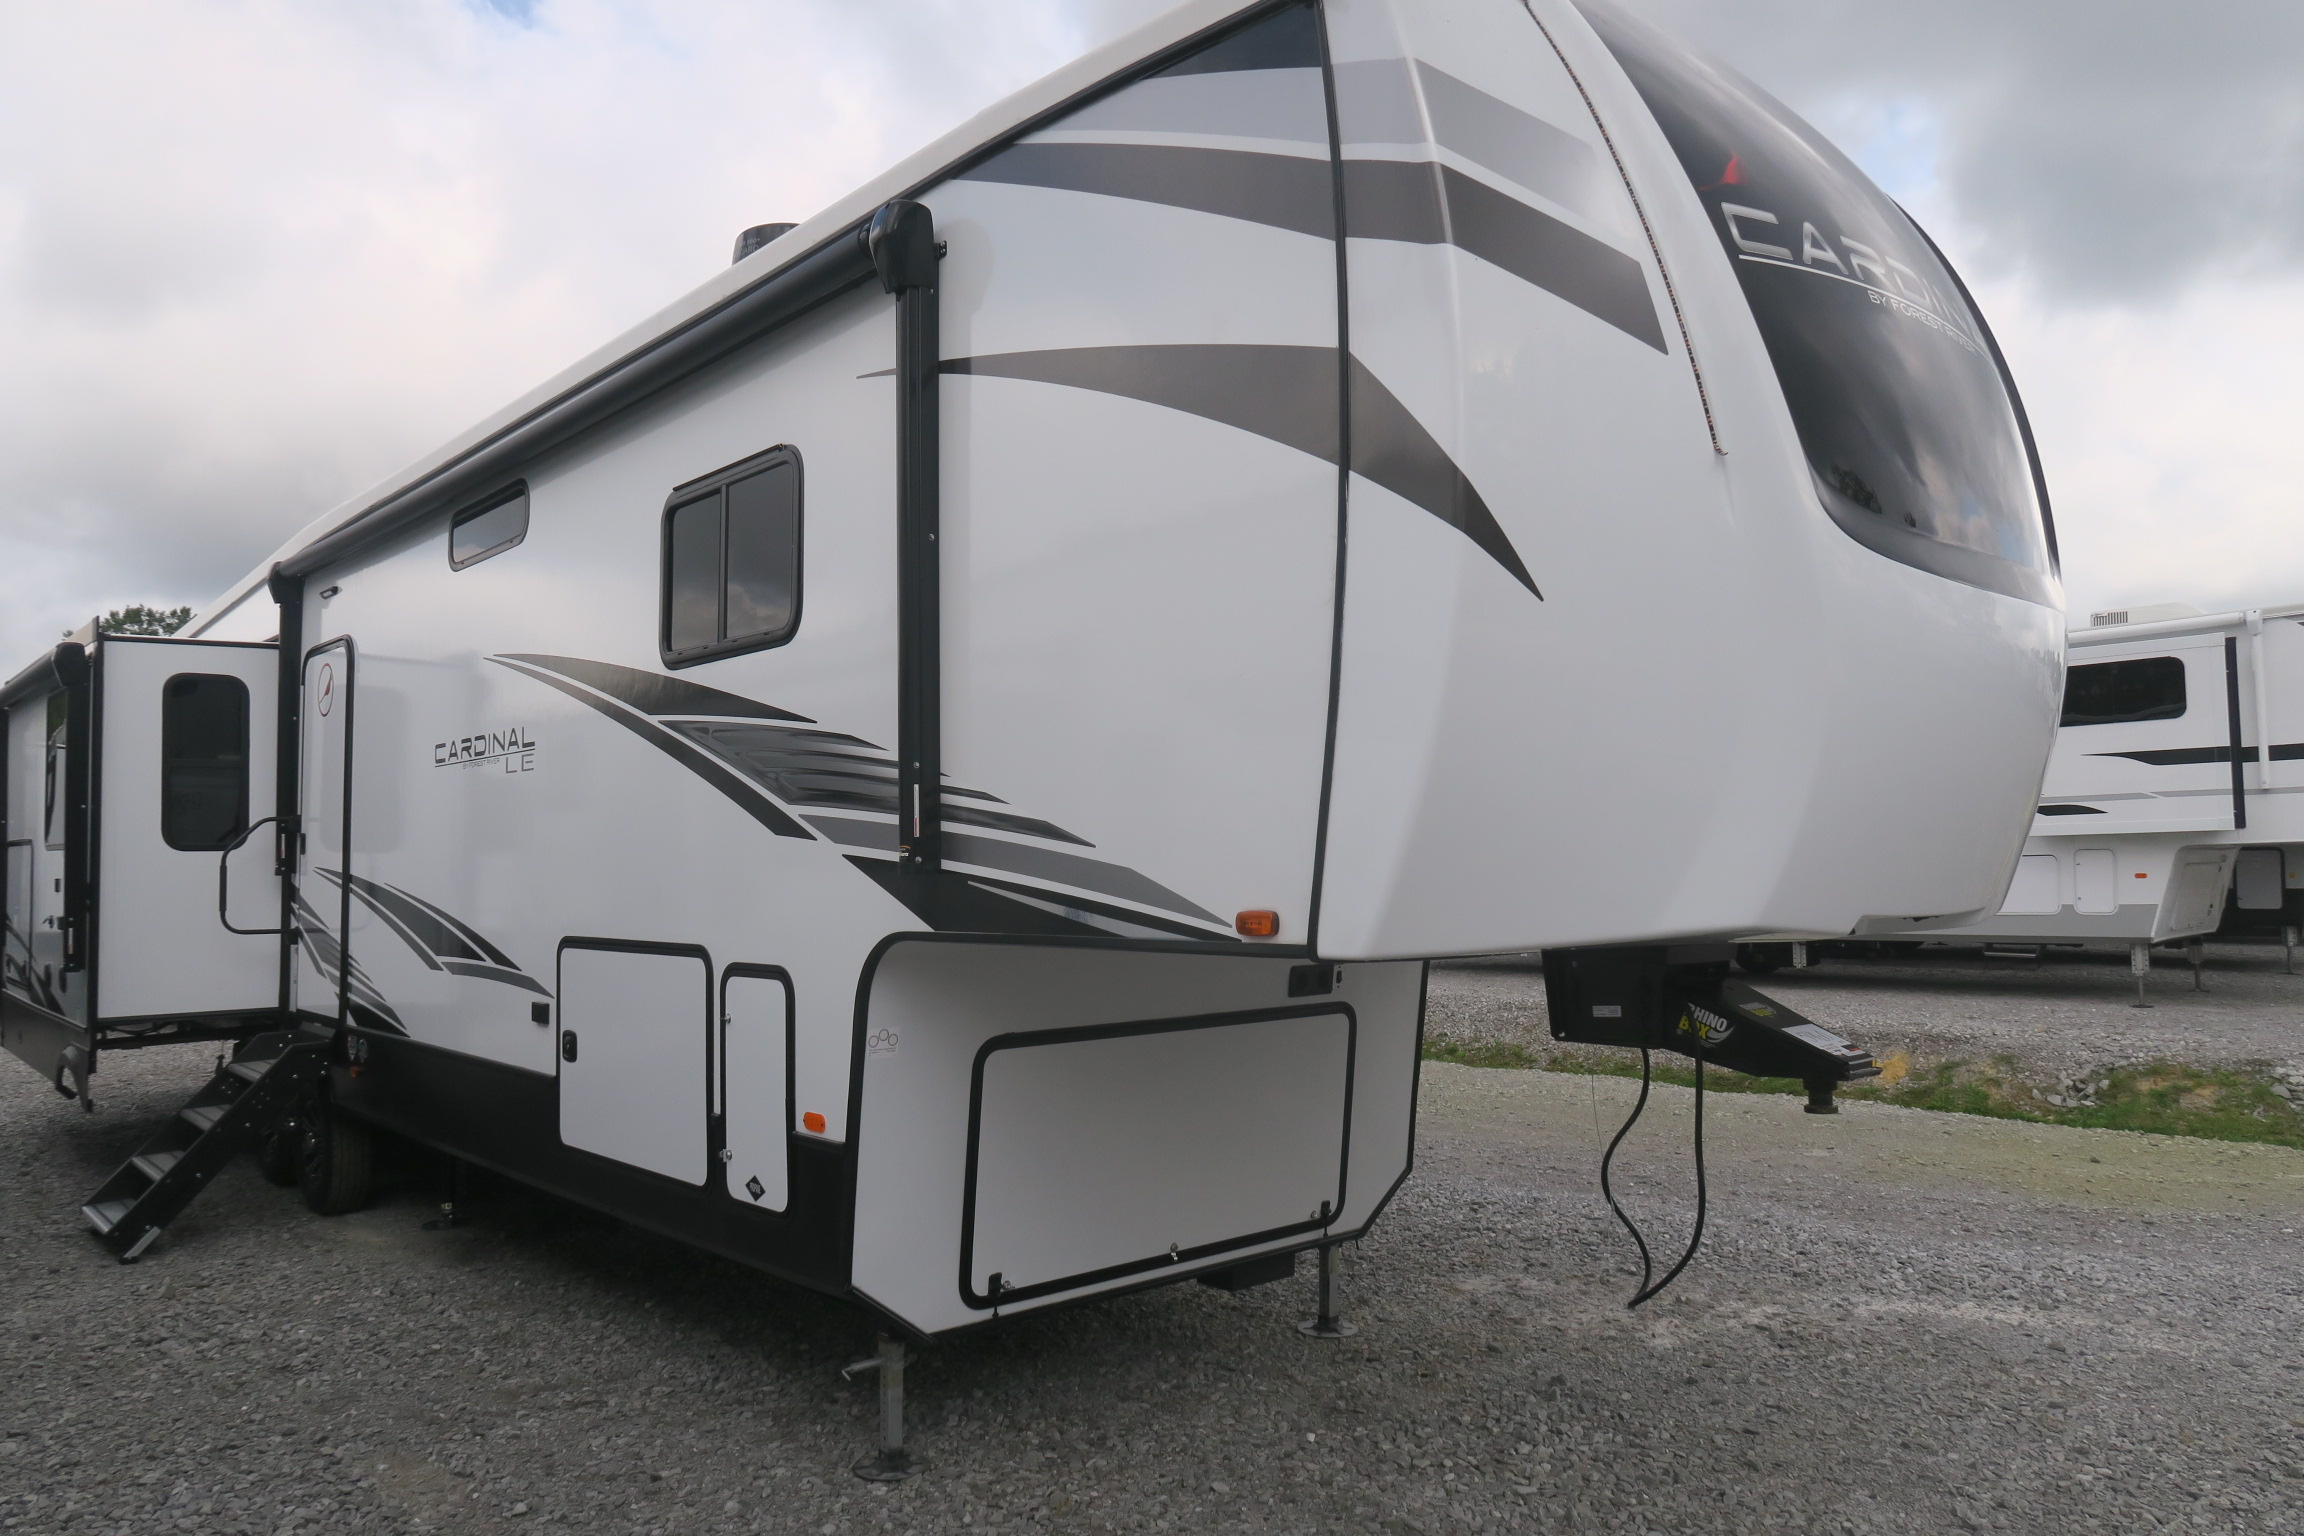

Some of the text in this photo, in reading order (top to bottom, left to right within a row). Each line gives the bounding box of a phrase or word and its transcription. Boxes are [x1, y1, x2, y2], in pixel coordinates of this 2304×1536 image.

[1868, 290, 1887, 306] BY
[1889, 298, 1945, 332] FOREST
[434, 726, 536, 764] CARDINAL
[505, 752, 535, 774] LE
[1678, 1014, 1711, 1040] BX
